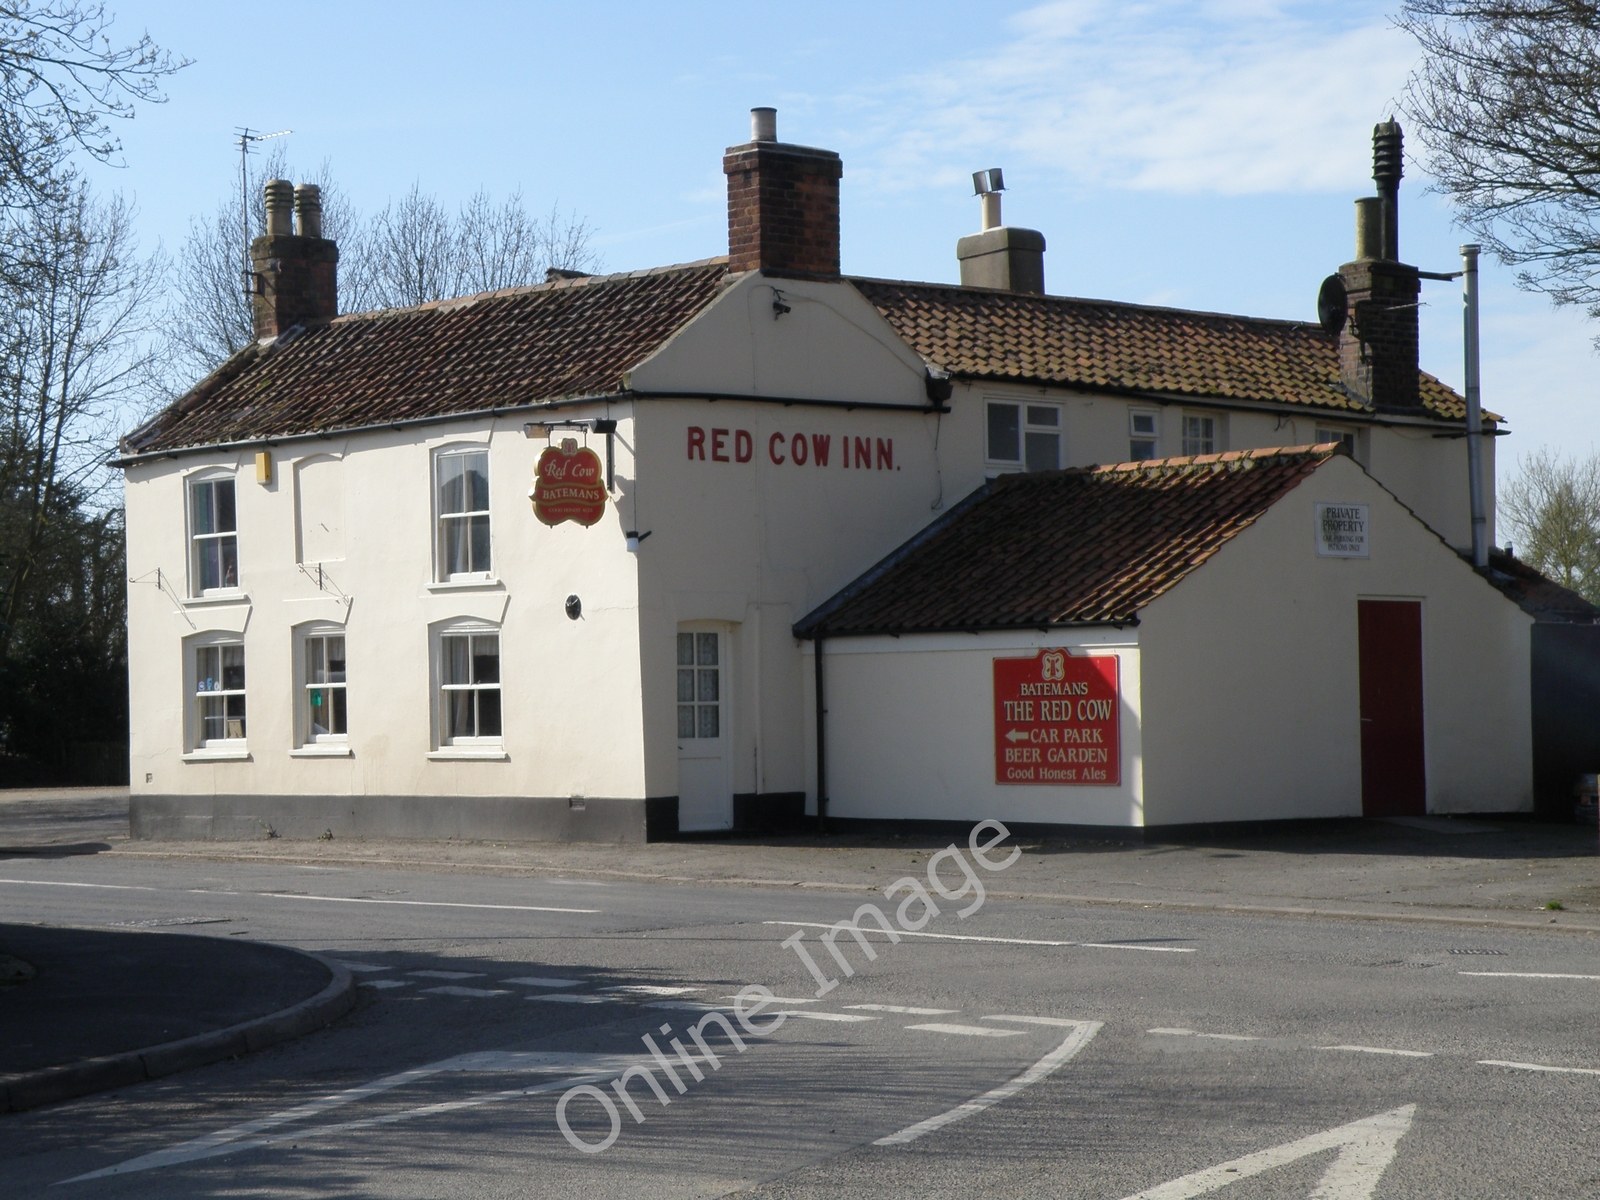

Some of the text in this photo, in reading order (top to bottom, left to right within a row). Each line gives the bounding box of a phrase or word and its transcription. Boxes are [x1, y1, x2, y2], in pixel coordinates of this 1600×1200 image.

[687, 426, 753, 463] RED
[768, 431, 831, 467] COW
[544, 459, 595, 479] Red Cow
[542, 487, 600, 499] BATEMANS
[1326, 507, 1360, 519] PRIVATE
[1322, 519, 1364, 532] PROPERTY
[1020, 682, 1088, 696] BATEMANS
[1003, 699, 1112, 721] THE RED COW
[1030, 728, 1103, 743] CAR PARK
[1005, 748, 1108, 763] BEER GARDEN
[1007, 766, 1106, 779] Good Honest Ales
